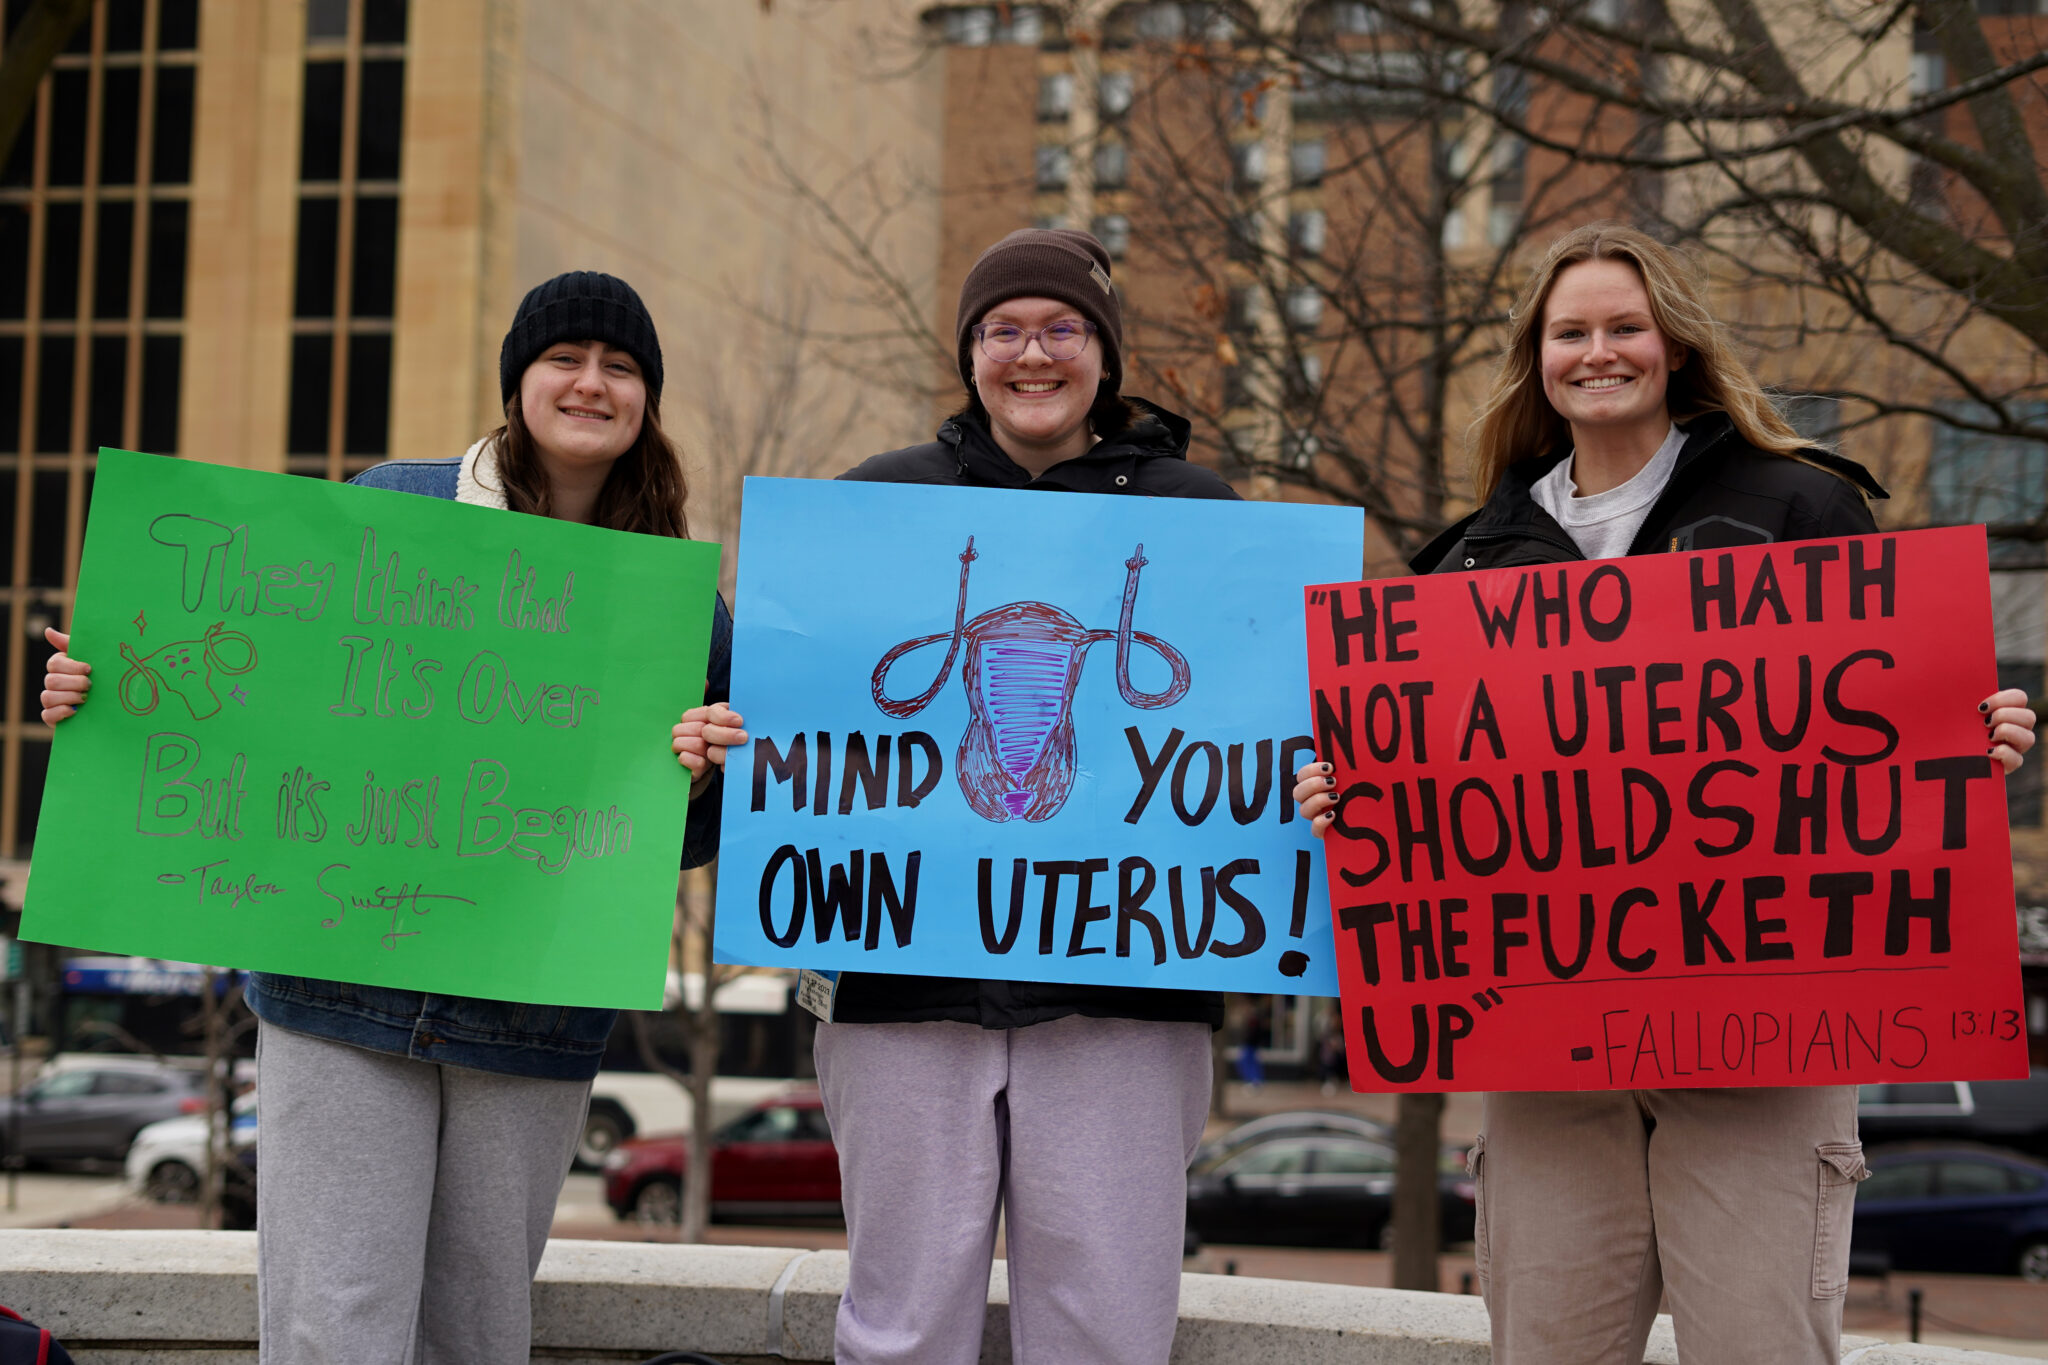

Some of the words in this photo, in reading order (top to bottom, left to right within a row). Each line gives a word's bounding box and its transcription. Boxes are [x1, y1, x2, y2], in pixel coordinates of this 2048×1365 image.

[149, 513, 336, 623] They
[352, 526, 480, 631] think
[499, 548, 576, 635] that
[1468, 564, 1632, 649] WHO
[1689, 537, 1897, 632] HATH
[328, 635, 444, 721] It's
[457, 650, 600, 729] Over
[1316, 681, 1434, 775] NOT
[1459, 678, 1507, 762] A
[1542, 649, 1901, 766] UTERUS
[136, 732, 248, 842] But
[276, 766, 331, 844] it's
[345, 770, 440, 850] just
[456, 758, 634, 876] Begun
[751, 731, 943, 817] MIND
[1333, 767, 1673, 888] SHOULD
[1687, 756, 1993, 857] SHUT
[316, 863, 477, 951] Swift
[759, 844, 921, 951] OWN
[978, 850, 1311, 978] UTERUS!
[1338, 898, 1470, 986] THE
[1491, 867, 1952, 981] FUCKETH
[1951, 1009, 2020, 1041] 13:13
